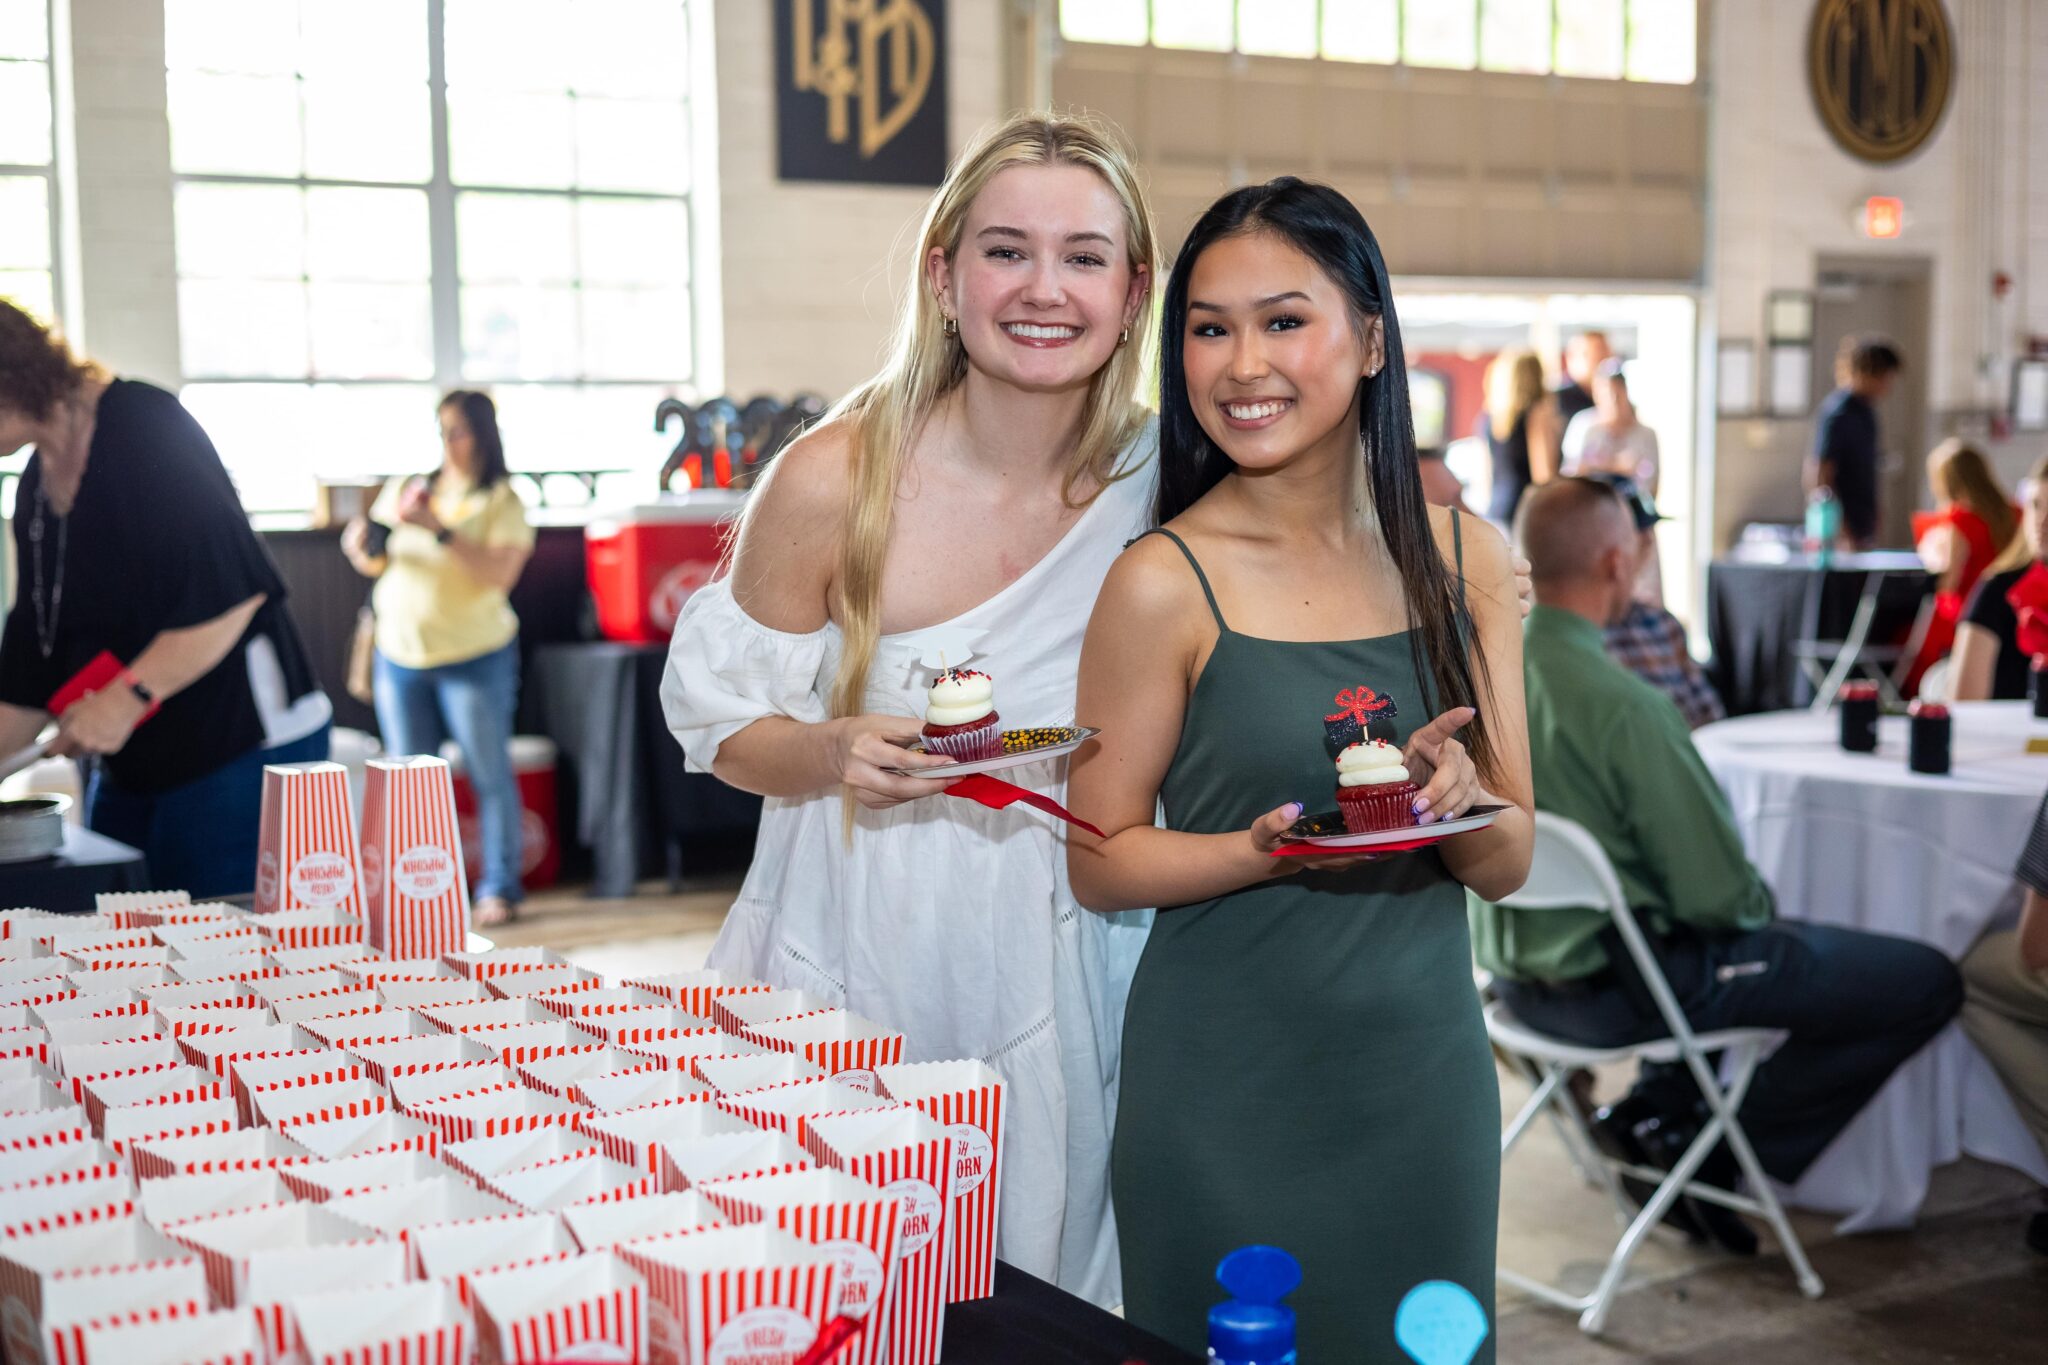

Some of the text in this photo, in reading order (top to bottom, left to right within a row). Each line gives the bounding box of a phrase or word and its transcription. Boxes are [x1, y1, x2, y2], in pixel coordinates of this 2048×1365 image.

[299, 864, 345, 881] POPCORN
[402, 858, 446, 874] POPCORN
[743, 1321, 786, 1350] FRESH
